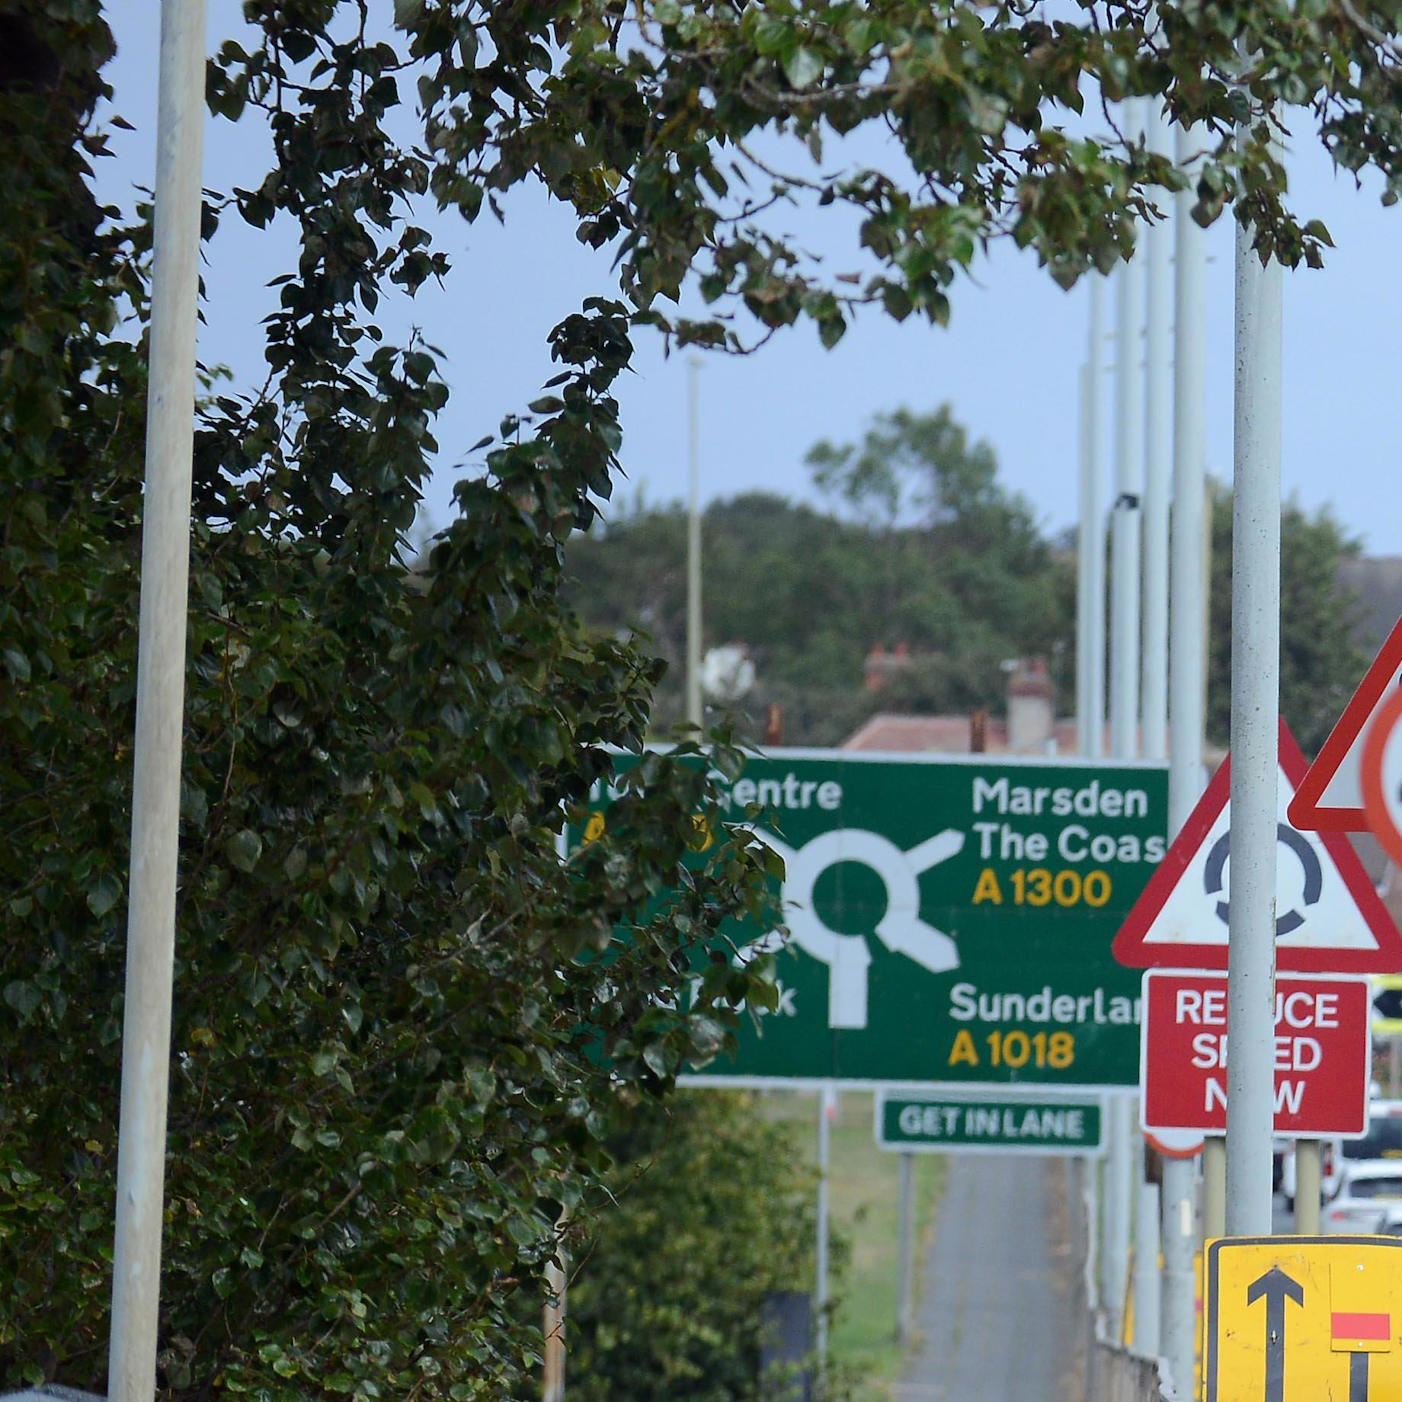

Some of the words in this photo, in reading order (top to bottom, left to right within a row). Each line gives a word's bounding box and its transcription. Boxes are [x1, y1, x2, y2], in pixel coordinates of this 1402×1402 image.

[972, 776, 1149, 817] Marsden
[972, 822, 1049, 861] The
[1057, 824, 1168, 863] Coas
[948, 982, 1142, 1024] Sunderla
[1175, 988, 1340, 1029] RECE
[1191, 1032, 1323, 1072] SED
[1204, 1077, 1306, 1115] NW
[899, 1104, 961, 1137] GET
[965, 1107, 999, 1138] IN
[1002, 1108, 1085, 1140] LANE
